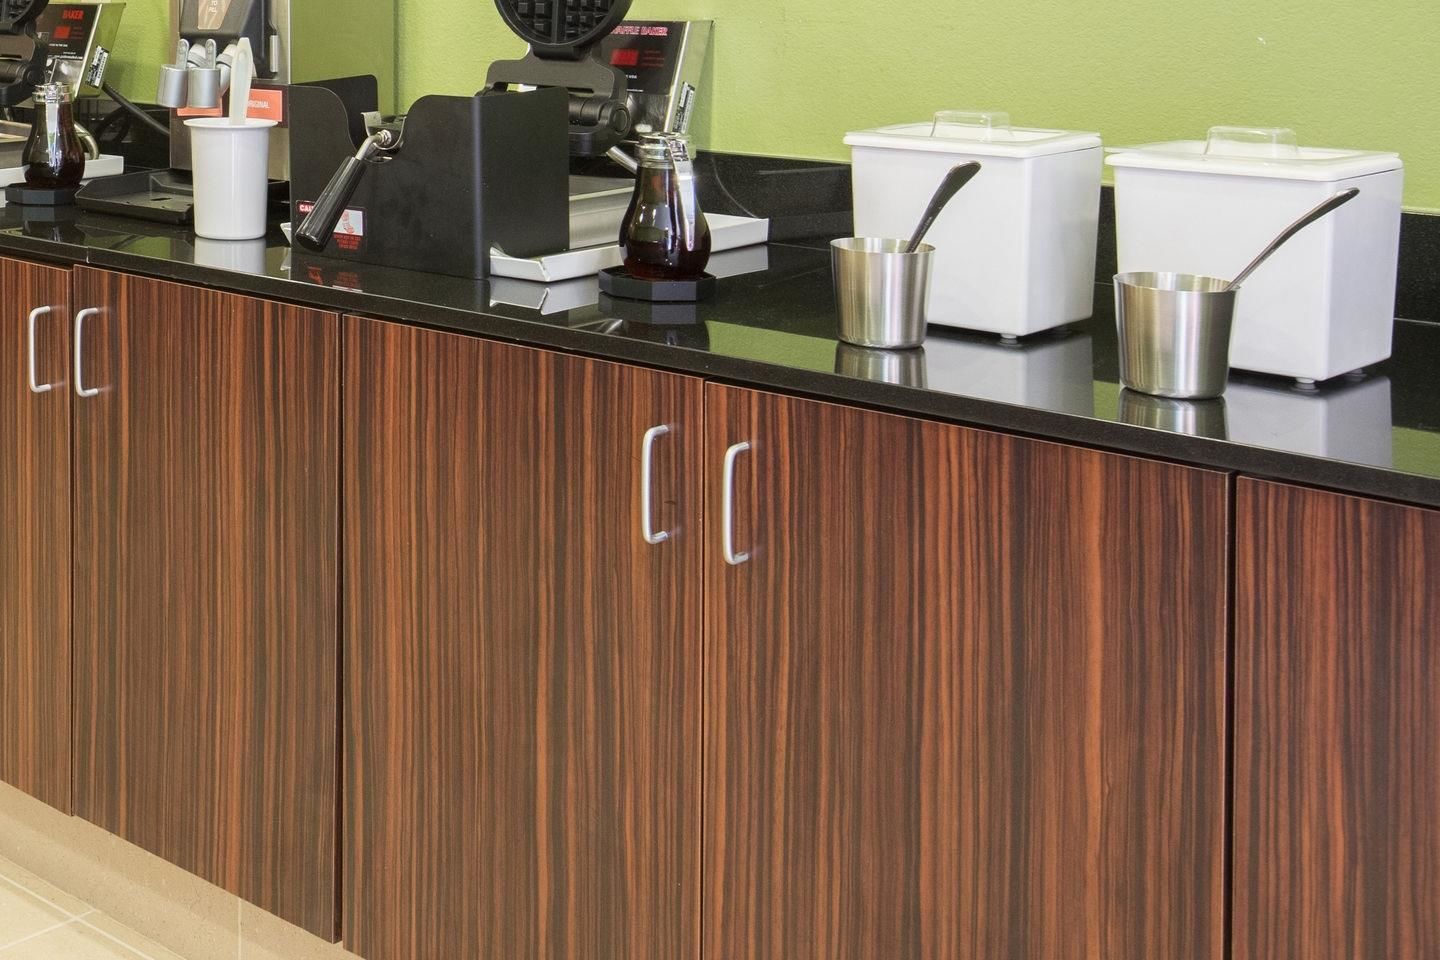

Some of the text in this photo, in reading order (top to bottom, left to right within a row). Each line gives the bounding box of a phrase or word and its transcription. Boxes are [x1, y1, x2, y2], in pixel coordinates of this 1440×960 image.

[62, 9, 84, 20] BAKER
[640, 26, 668, 36] BAKER
[247, 100, 271, 109] RIGINAL
